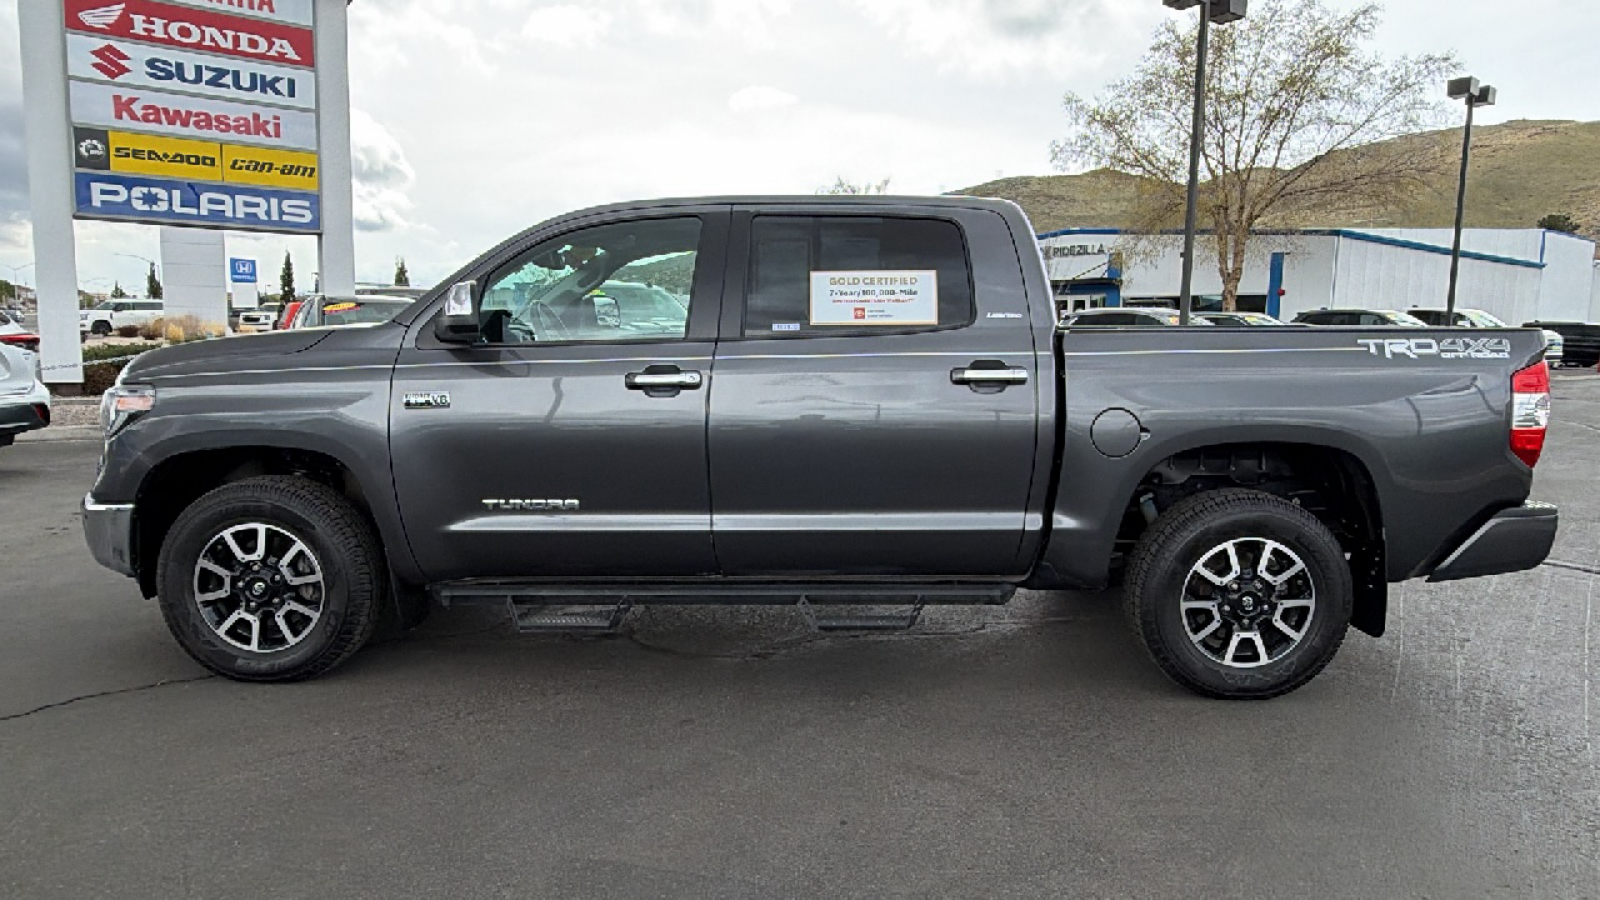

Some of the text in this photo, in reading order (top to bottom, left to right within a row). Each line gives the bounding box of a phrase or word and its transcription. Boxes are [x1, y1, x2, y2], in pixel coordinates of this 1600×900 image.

[129, 13, 302, 61] HONDA
[144, 56, 296, 98] SUZUKI
[111, 94, 281, 138] Kawasaki
[89, 181, 313, 224] POLARIS
[1053, 243, 1106, 257] RIDEZILLA
[829, 276, 918, 286] GOLD CERTIFIED
[1357, 338, 1440, 360] TRD
[481, 498, 580, 511] TUNDRA
